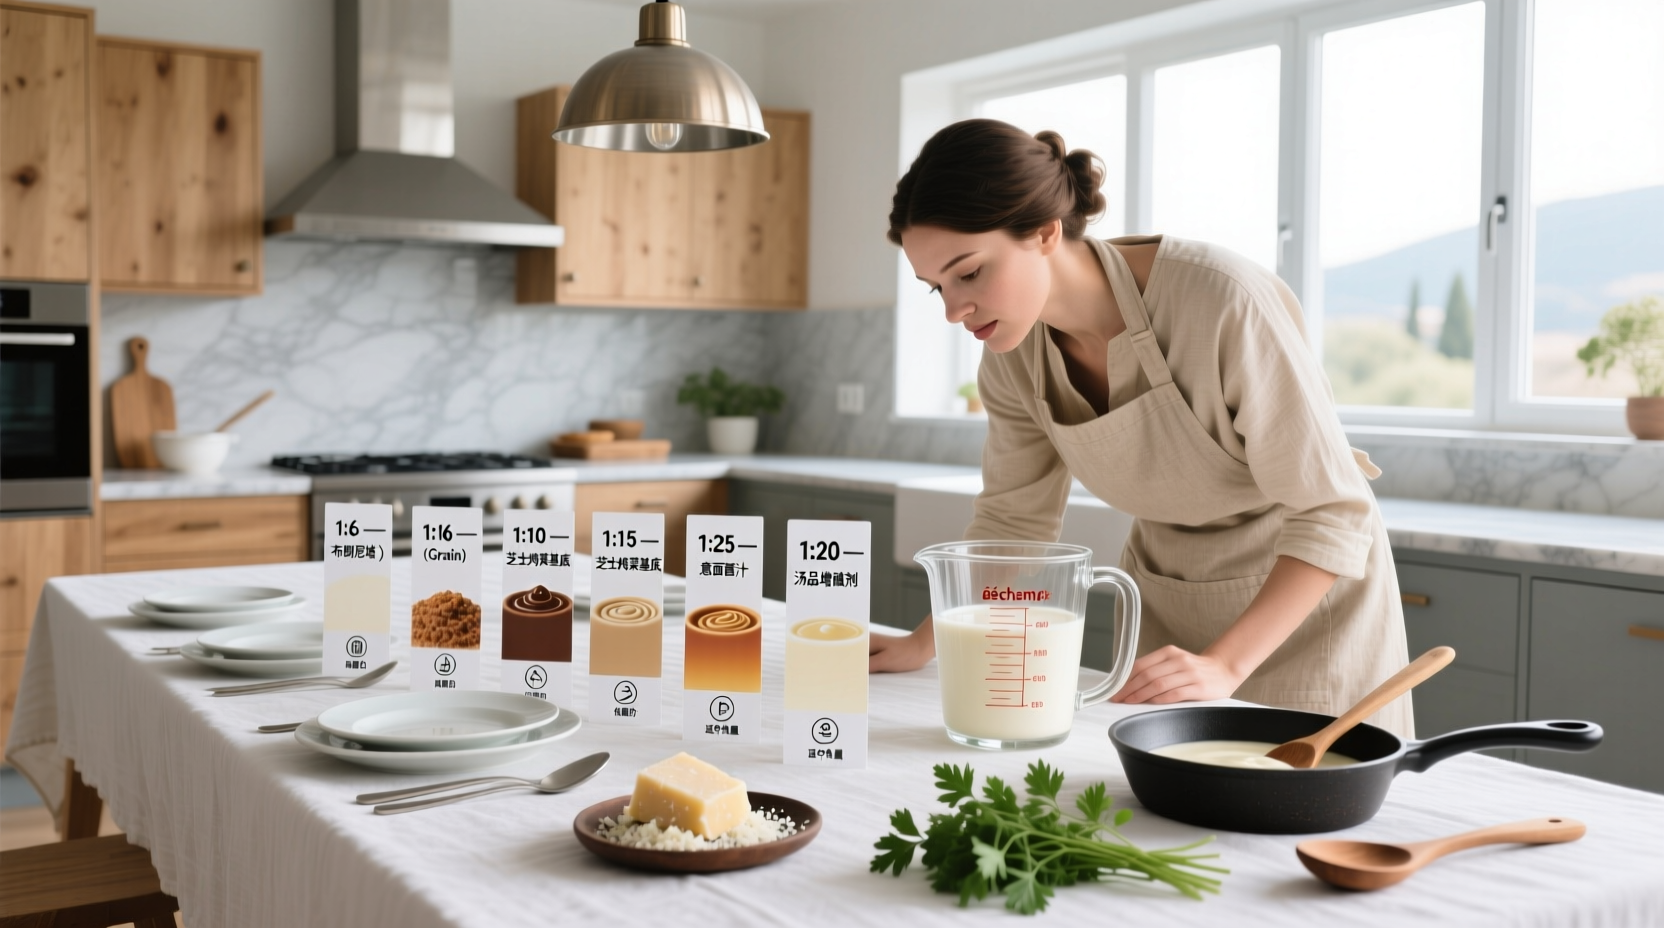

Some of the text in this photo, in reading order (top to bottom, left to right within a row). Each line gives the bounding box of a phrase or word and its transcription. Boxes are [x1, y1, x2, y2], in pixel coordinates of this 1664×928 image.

[335, 519, 360, 537] 1:6
[512, 526, 547, 544] 1:10
[602, 529, 637, 548] 1:15
[698, 534, 735, 554] 1:25
[799, 540, 841, 561] 1:20
